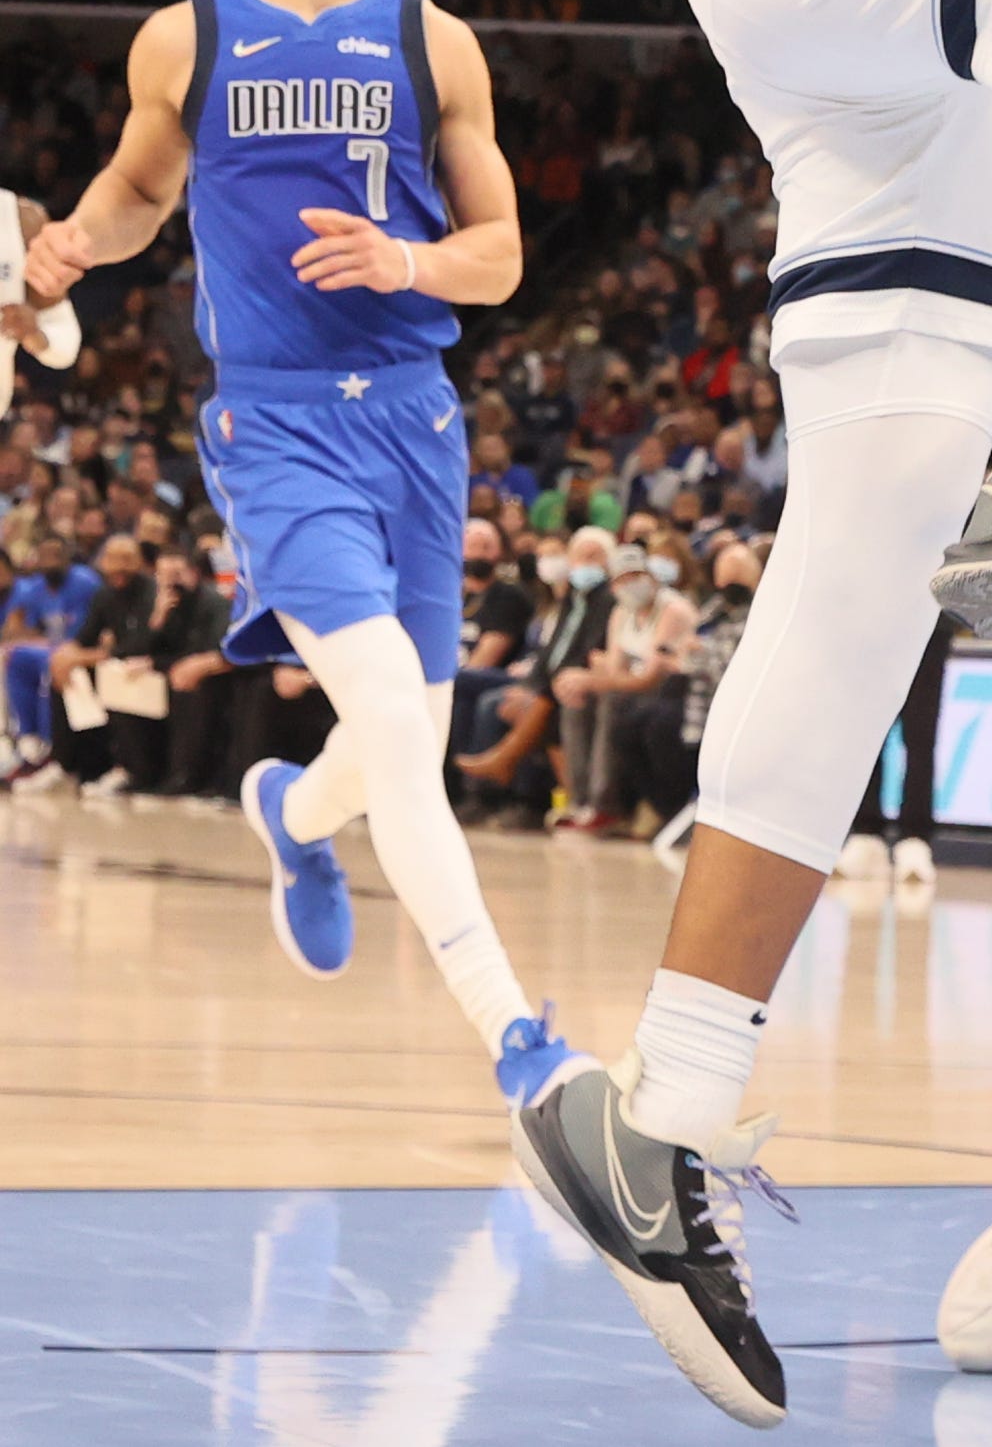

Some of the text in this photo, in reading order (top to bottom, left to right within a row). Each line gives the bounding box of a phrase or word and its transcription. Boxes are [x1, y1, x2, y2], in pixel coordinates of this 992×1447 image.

[336, 36, 392, 59] chime
[227, 77, 394, 138] DALLAS
[347, 138, 391, 222] 7
